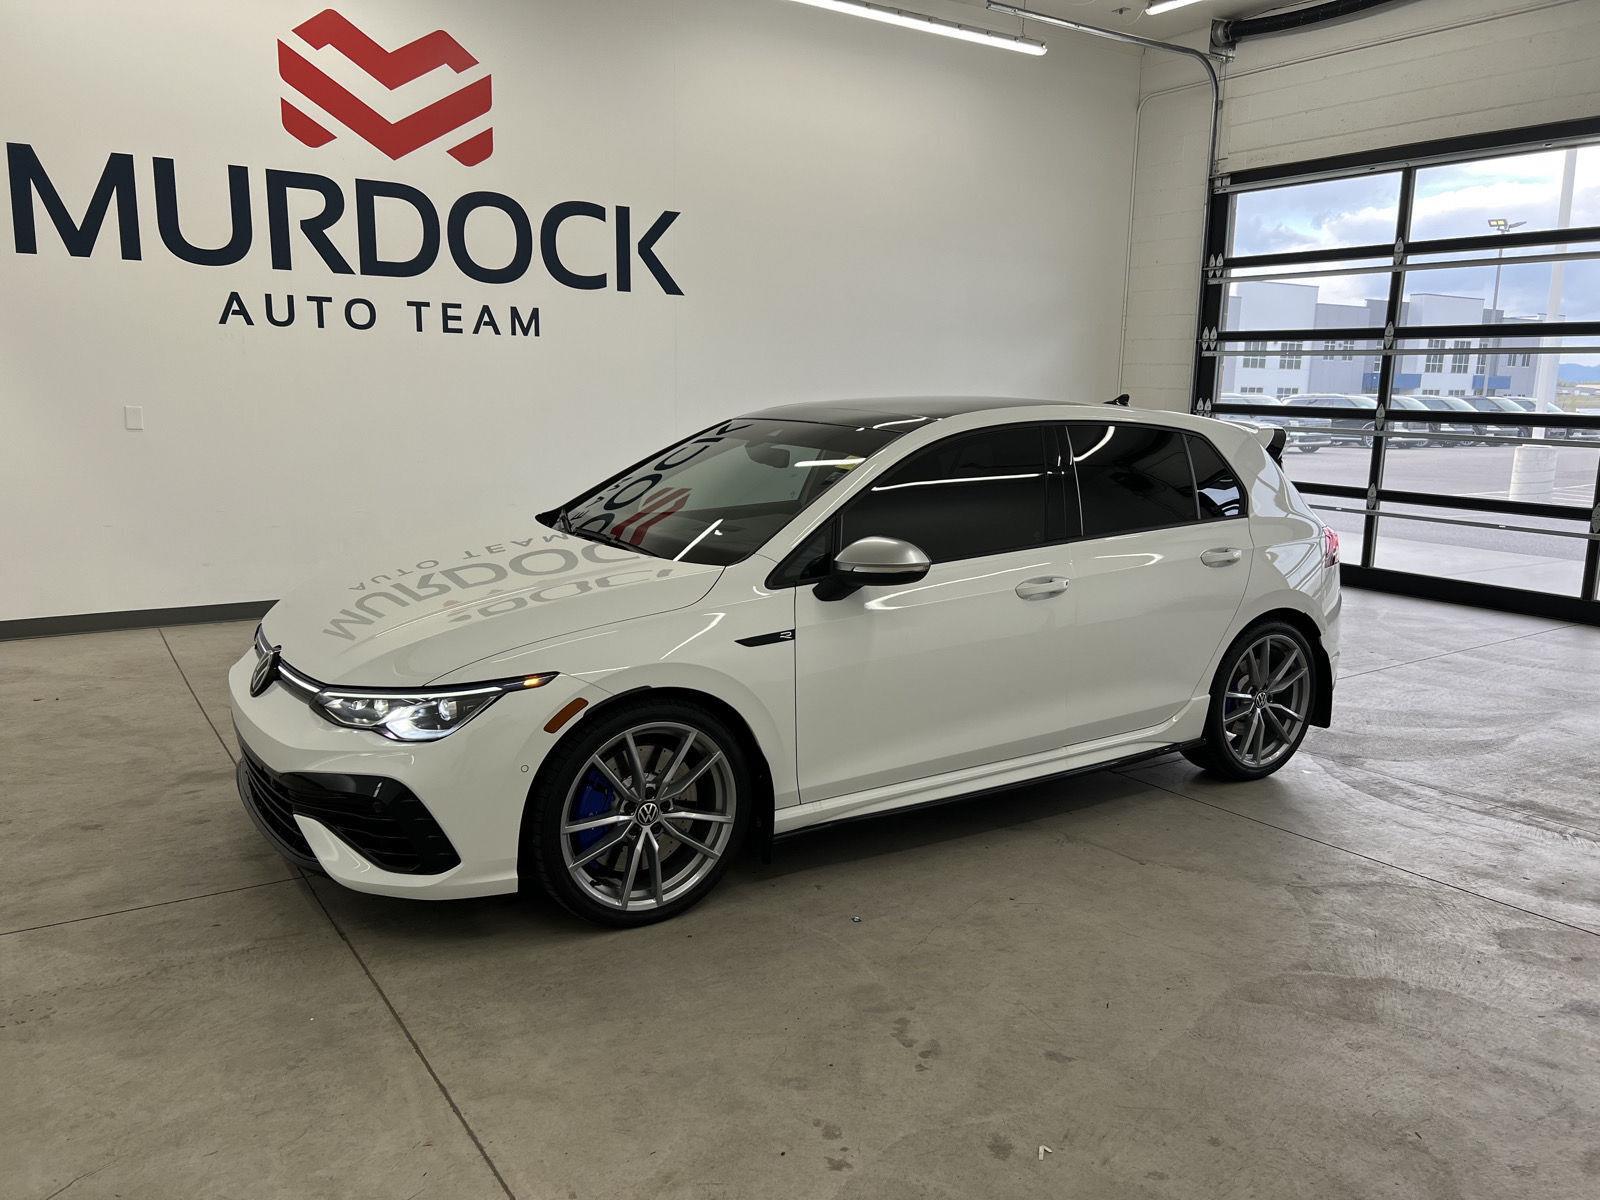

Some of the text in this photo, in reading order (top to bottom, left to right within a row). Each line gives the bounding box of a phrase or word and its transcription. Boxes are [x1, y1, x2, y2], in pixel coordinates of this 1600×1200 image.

[6, 142, 685, 296] MURDOCK
[219, 291, 541, 337] AUTO TEAM
